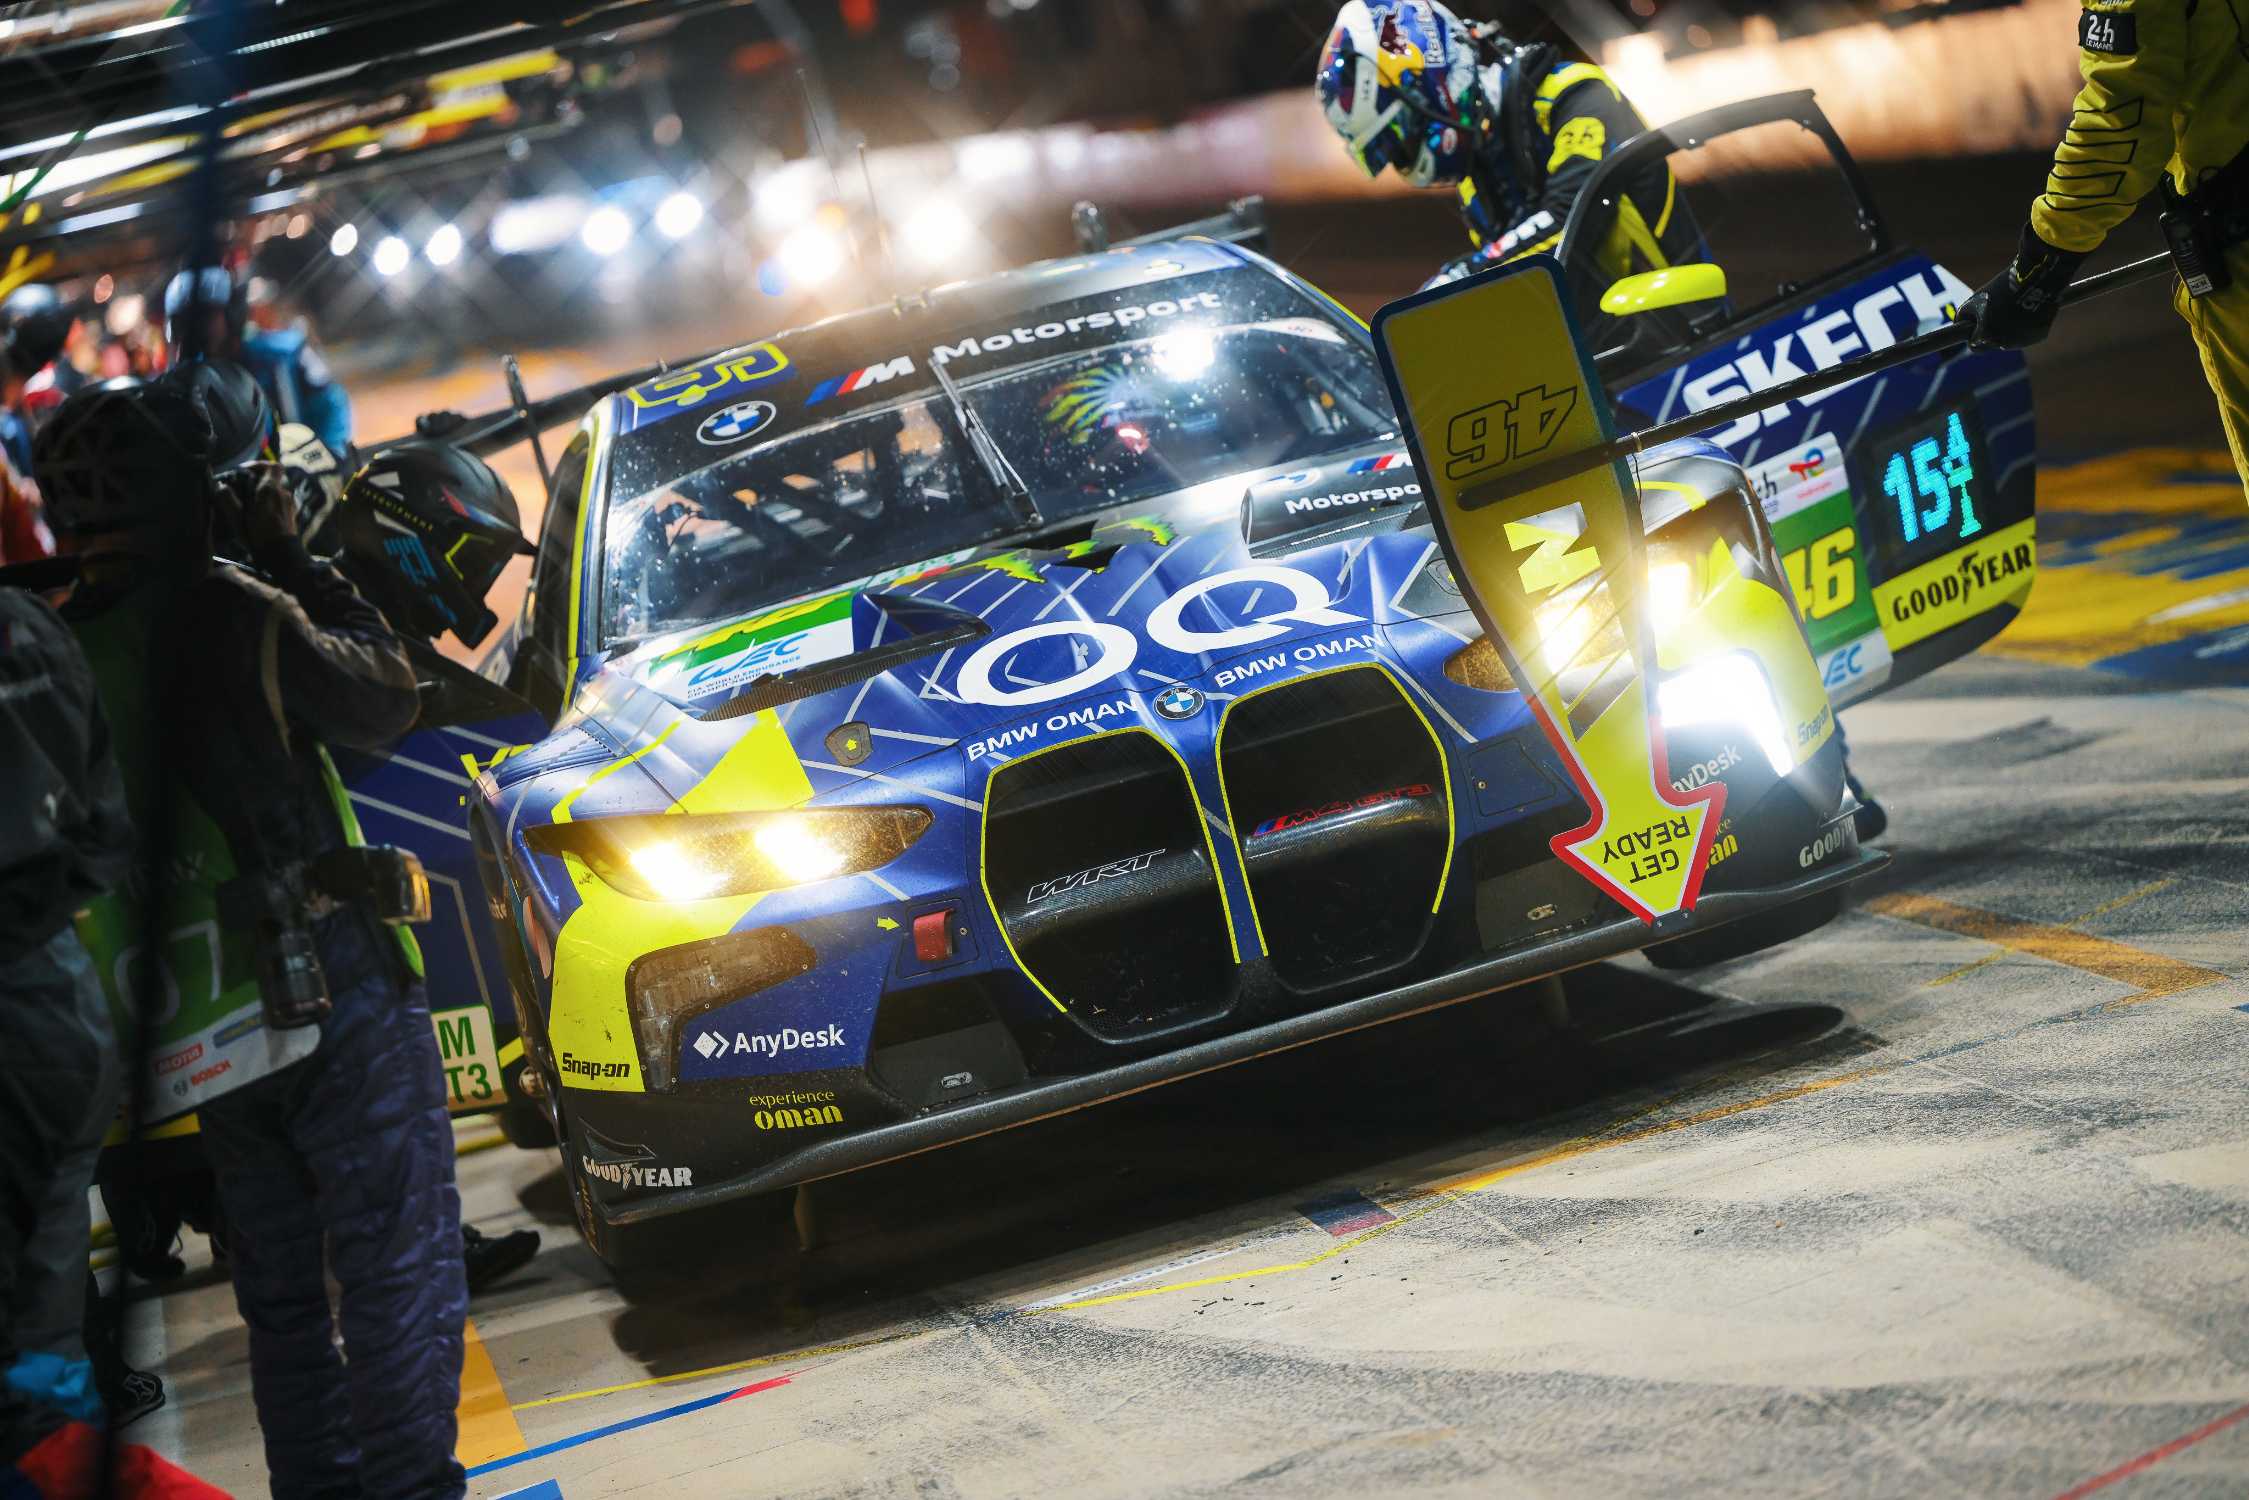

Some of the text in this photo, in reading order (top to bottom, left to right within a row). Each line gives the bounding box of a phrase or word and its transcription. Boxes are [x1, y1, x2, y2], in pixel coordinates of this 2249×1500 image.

[2086, 39, 2093, 48] LE
[2087, 15, 2114, 43] 24h
[931, 289, 1222, 364] Motorsport
[1682, 264, 1975, 448] SKECH
[1446, 384, 1577, 481] 46
[1284, 483, 1421, 515] Motorspo
[1892, 540, 2033, 622] GOODYEAR
[687, 633, 809, 686] WEC
[743, 655, 802, 678] ENDURANCE
[1214, 632, 1386, 689] BMW OMAN
[1824, 643, 1862, 688] EC
[967, 700, 1138, 761] BMW OMAN
[1672, 745, 1742, 793] nyDesk
[1603, 815, 1691, 863] READY
[1027, 848, 1166, 904] WRT
[1629, 848, 1680, 885] GET
[438, 1015, 476, 1061] M
[733, 1024, 845, 1057] AnyDesk
[443, 1062, 493, 1104] T3
[561, 1052, 630, 1081] Snap-on
[749, 1089, 835, 1108] experience
[754, 1104, 843, 1130] oman
[583, 1155, 692, 1190] GOODYEAR
